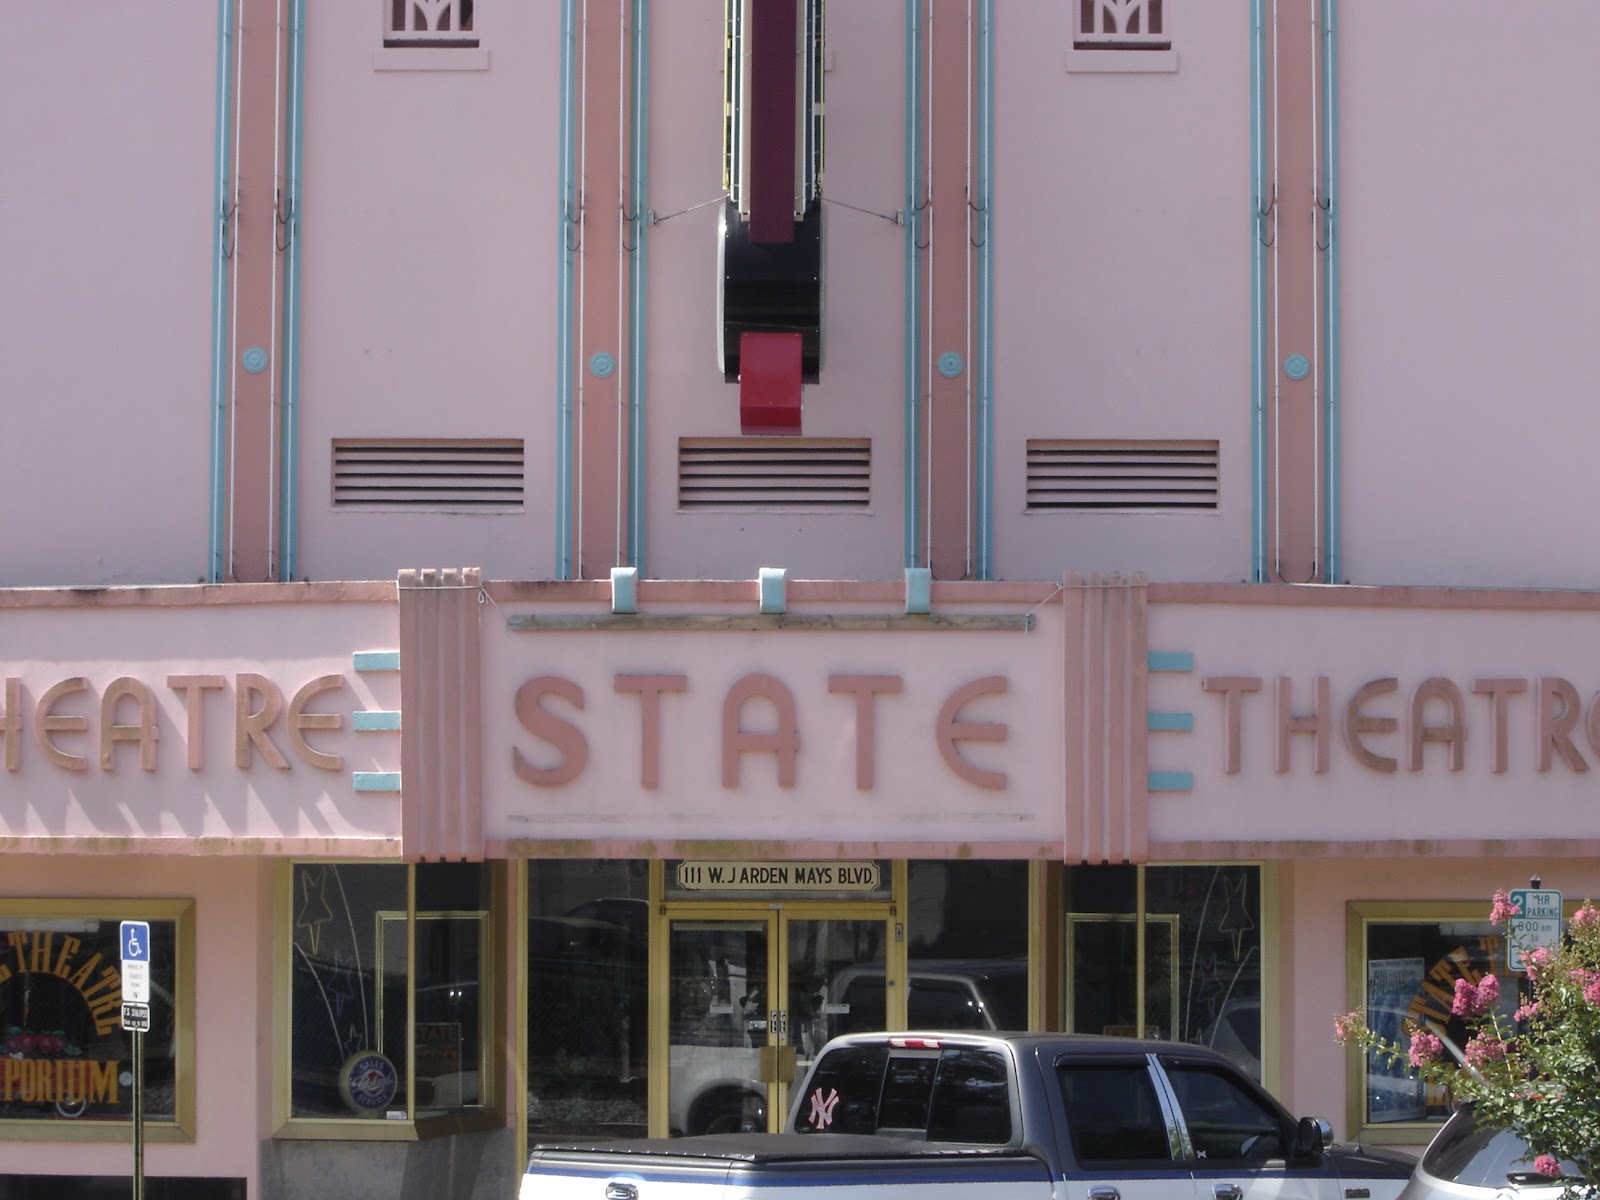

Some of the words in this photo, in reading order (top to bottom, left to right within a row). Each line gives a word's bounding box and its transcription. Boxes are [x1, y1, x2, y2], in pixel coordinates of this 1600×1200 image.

[512, 672, 1009, 791] STATE
[1202, 675, 1600, 774] THEATR
[685, 867, 702, 884] 111
[795, 867, 833, 884] MAYS
[838, 867, 875, 885] BLVD.
[1526, 907, 1560, 918] PARKING
[1537, 894, 1551, 905] HR
[0, 1058, 120, 1104] PORIUM
